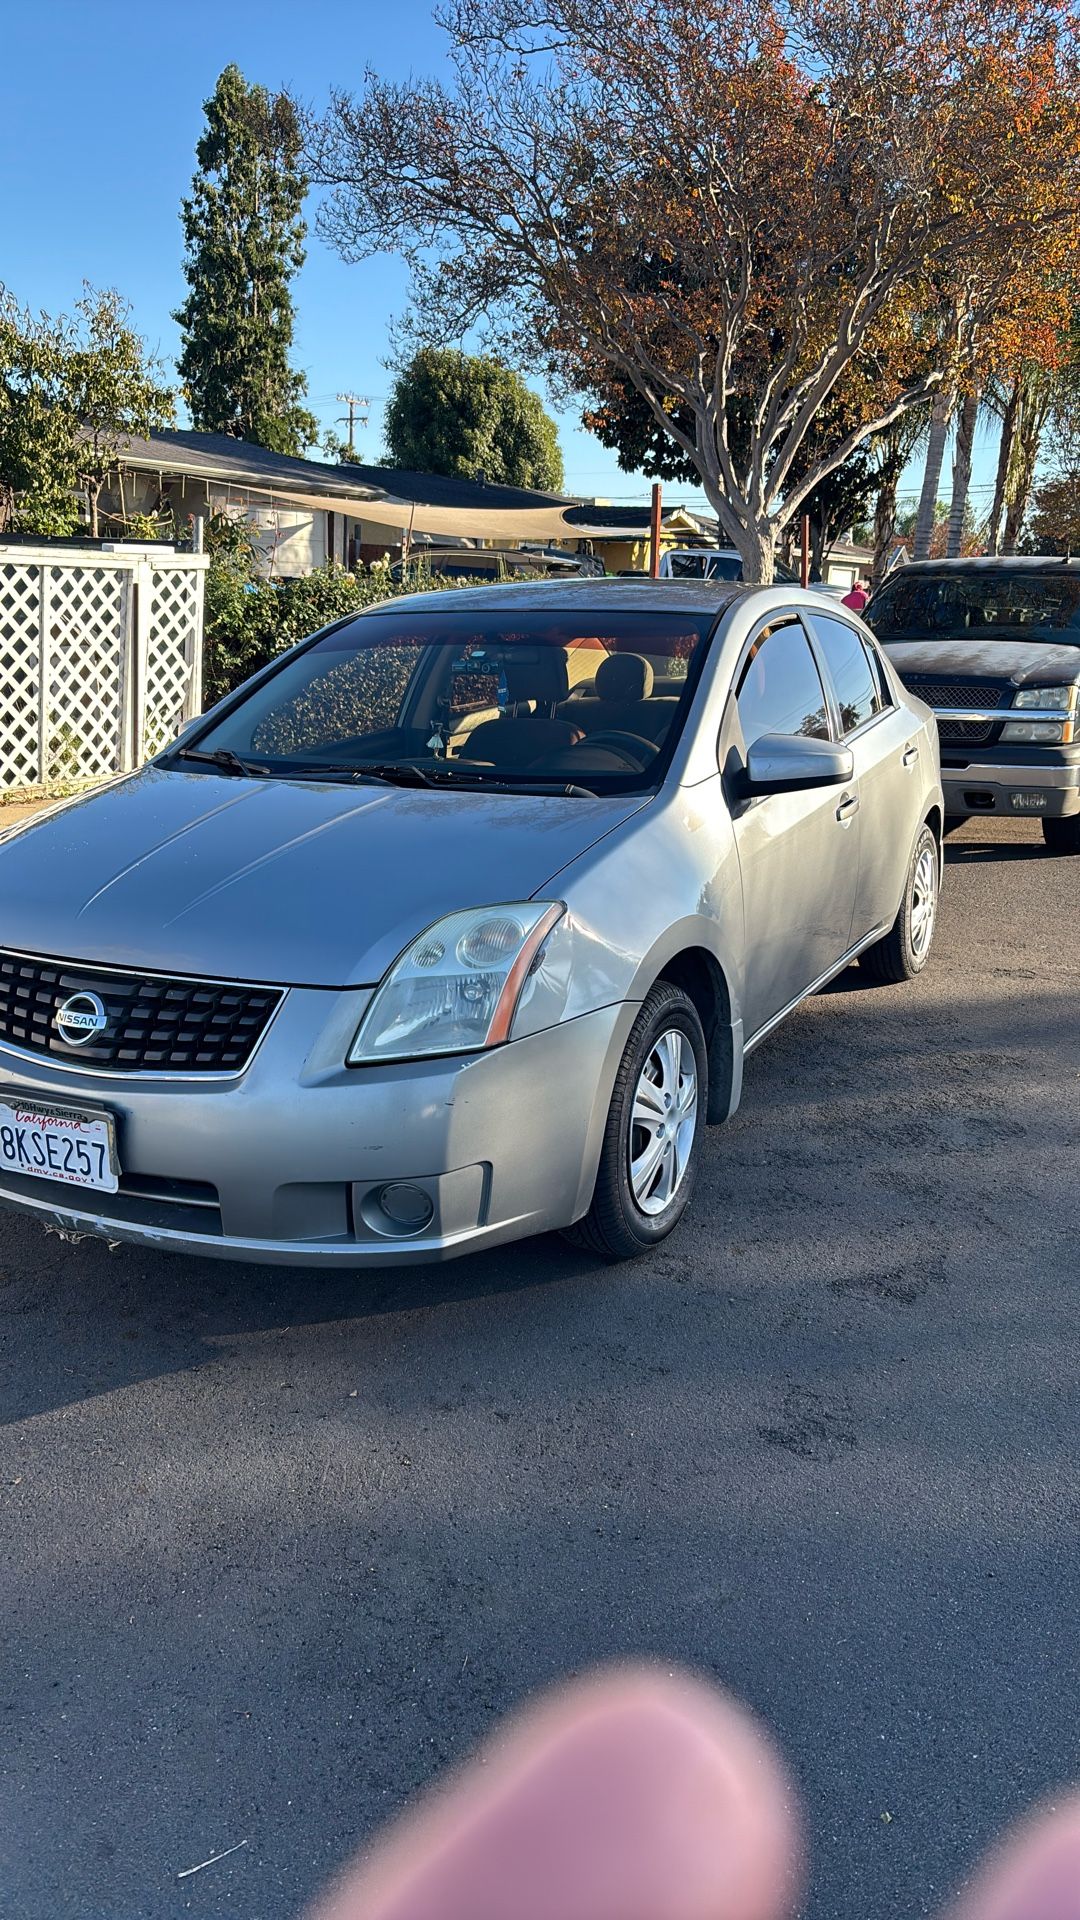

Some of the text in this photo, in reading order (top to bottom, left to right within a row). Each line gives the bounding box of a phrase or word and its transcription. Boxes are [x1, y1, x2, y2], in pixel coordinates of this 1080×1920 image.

[58, 1012, 98, 1026] NISSAN
[15, 1109, 90, 1133] California
[55, 1108, 82, 1120] Sierra
[0, 1125, 106, 1180] 8KSE257
[27, 1166, 88, 1183] dmv.ca.gov
